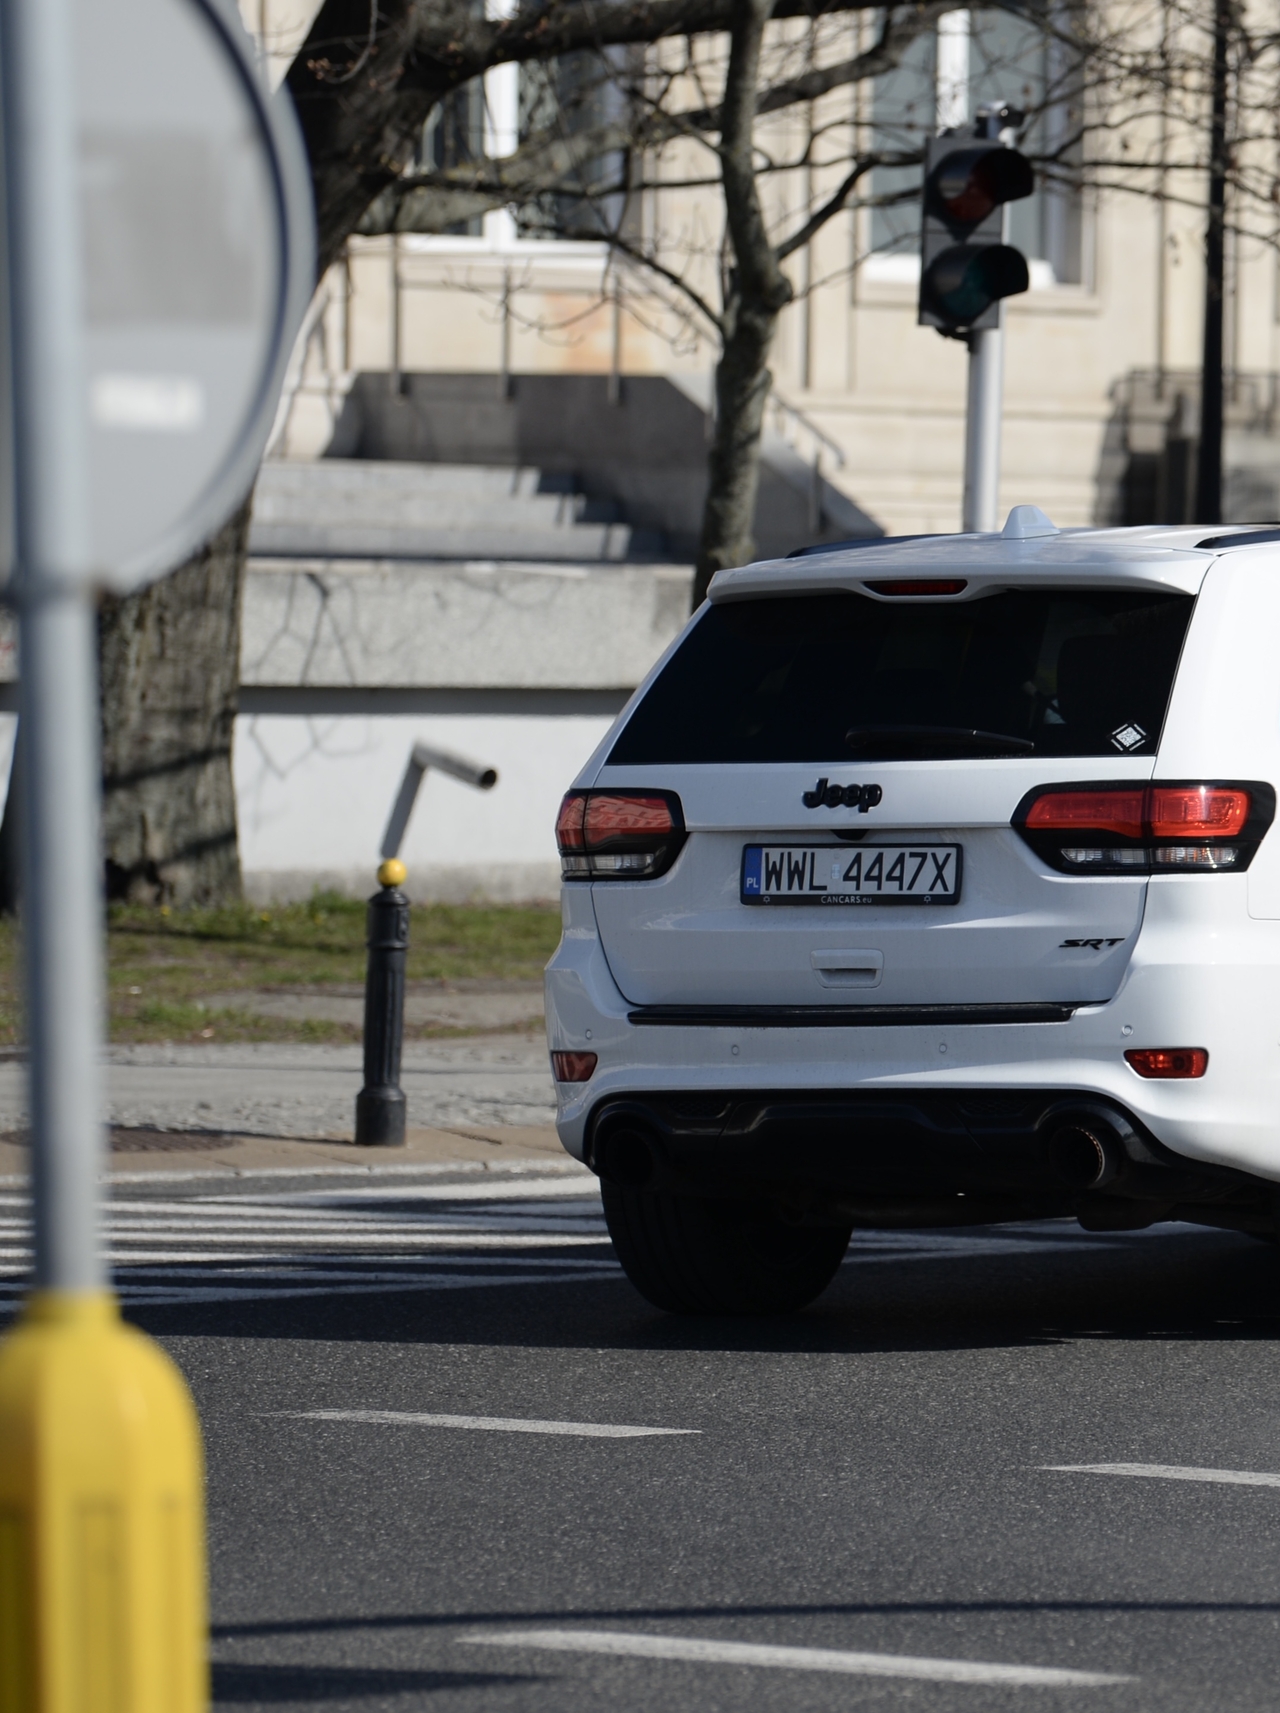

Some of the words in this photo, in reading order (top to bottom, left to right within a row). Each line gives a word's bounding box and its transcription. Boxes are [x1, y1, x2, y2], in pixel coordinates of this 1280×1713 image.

[802, 778, 883, 813] Jeep
[764, 852, 828, 892] WWL
[842, 852, 952, 892] 4447X
[746, 877, 759, 888] PL
[820, 896, 873, 904] CANCARS.eu
[1058, 938, 1126, 950] SRT
